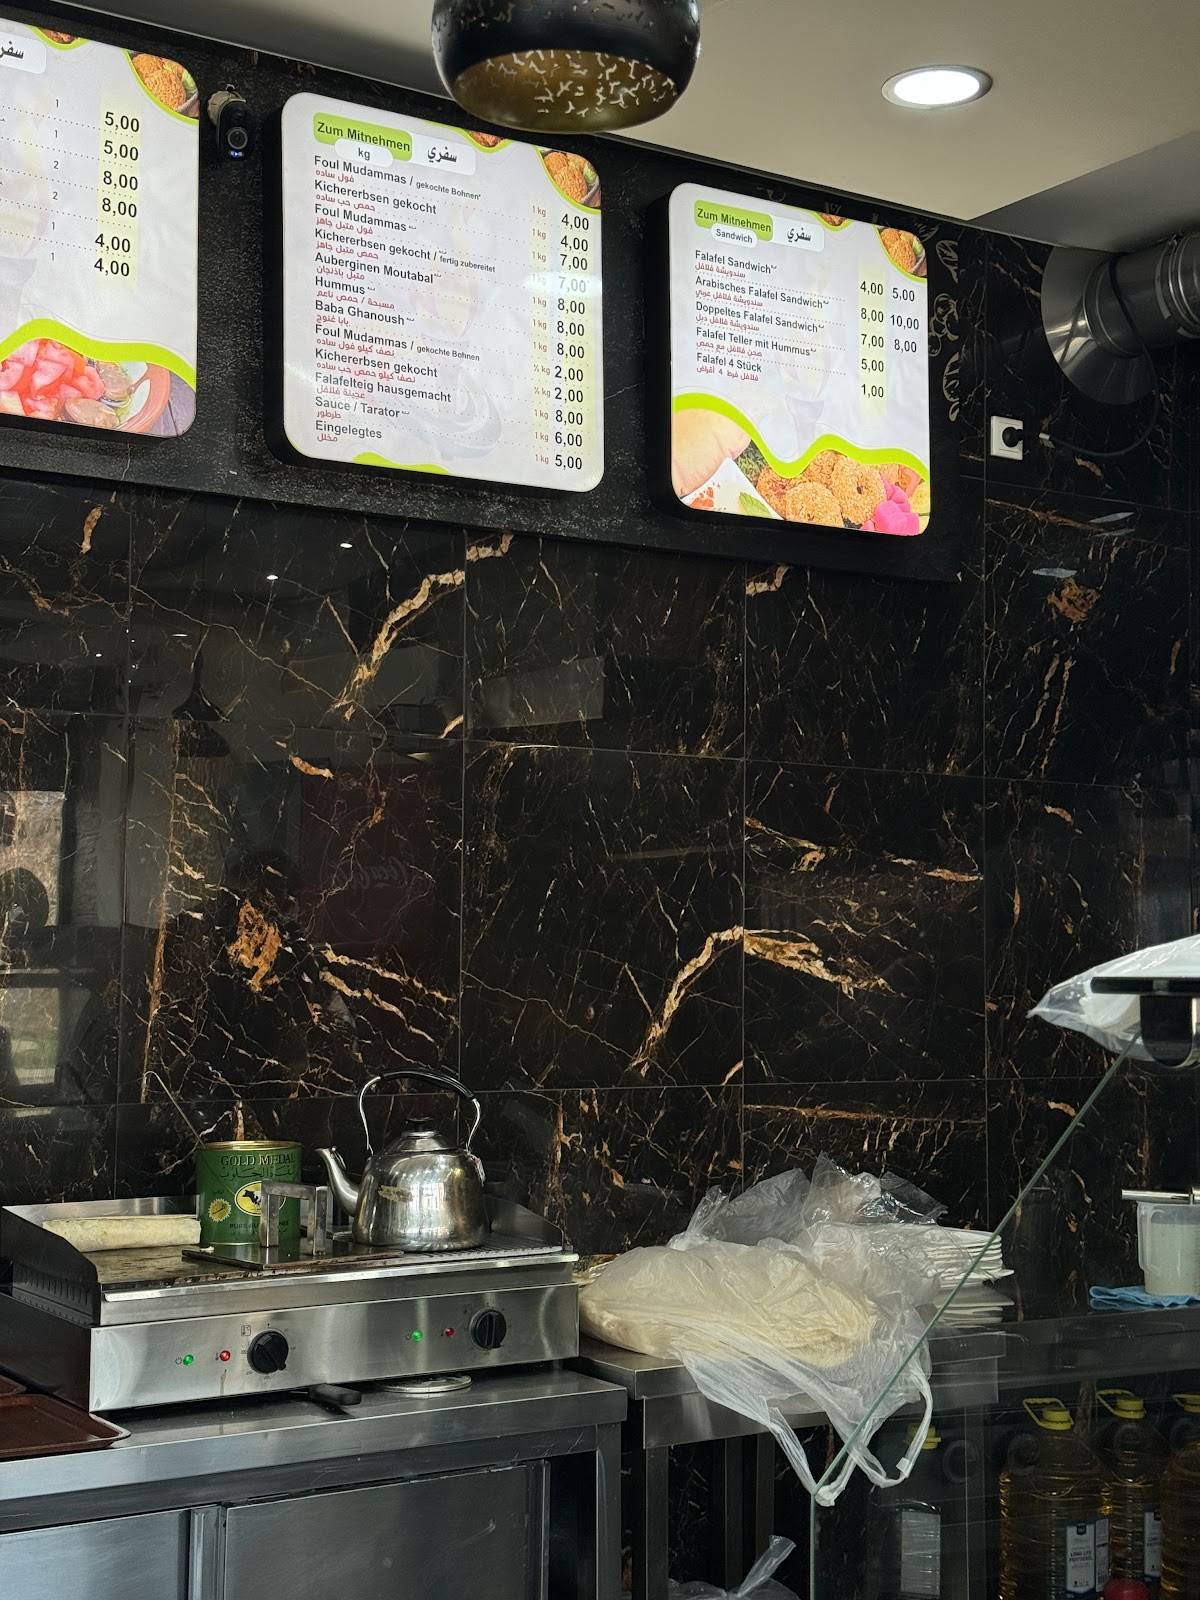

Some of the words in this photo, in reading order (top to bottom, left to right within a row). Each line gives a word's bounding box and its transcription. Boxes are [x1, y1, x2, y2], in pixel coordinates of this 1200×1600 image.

[104, 112, 139, 132] 5,00
[316, 122, 343, 137] Zum
[347, 128, 410, 152] Mitnehmen
[103, 140, 138, 160] 5,00
[358, 148, 370, 160] kg
[427, 145, 457, 164] سفري
[103, 171, 138, 190] 8,00
[314, 156, 339, 168] Foul
[343, 160, 406, 184] Mudammas
[416, 181, 449, 194] gekochte
[314, 180, 389, 204] Kichererbsen
[393, 198, 436, 214] gekocht
[102, 198, 137, 218] 8,00
[315, 204, 339, 218] Foul
[538, 207, 546, 217] kg
[562, 214, 589, 230] 4,00
[697, 208, 718, 220] Zum
[721, 213, 771, 232] Mitnehmen
[95, 234, 130, 253] 4,00
[538, 230, 546, 239] kg
[561, 236, 588, 252] 4,00
[716, 229, 753, 243] Sandwich
[787, 227, 812, 243] سفري
[315, 228, 386, 252] Kichererbsen
[389, 244, 430, 260] gekocht
[440, 255, 458, 266] fertig
[460, 260, 496, 272] zubereitet
[696, 250, 725, 264] Falafel
[94, 258, 130, 277] 4,00
[315, 252, 380, 274] Auberginen
[538, 253, 546, 262] kg
[560, 254, 587, 270] 7,00
[559, 276, 586, 292] 7,00
[696, 276, 746, 294] Arabisches
[749, 287, 778, 300] Falafel
[860, 281, 883, 295] 4,00
[892, 288, 915, 302] 5,00
[315, 300, 344, 314] Baba
[538, 298, 546, 307] kg
[558, 298, 585, 314] 8,00
[696, 301, 741, 318] Doppeltes
[744, 311, 772, 324] Falafel
[538, 320, 547, 330] kg
[557, 321, 584, 336] 8,00
[861, 308, 884, 322] 8,00
[890, 315, 919, 330] 10,00
[316, 324, 340, 338] Foul
[344, 329, 407, 349] Mudammas
[417, 344, 450, 356] gekochte
[452, 351, 480, 361] Bohnen
[696, 327, 726, 340] Falafel
[728, 333, 753, 345] Teller
[755, 338, 768, 349] mit
[861, 334, 884, 348] 7,00
[894, 339, 917, 353] 8,00
[539, 342, 547, 352] kg
[557, 343, 584, 358] 8,00
[316, 348, 390, 370] Kichererbsen
[394, 362, 438, 378] gekocht
[697, 353, 726, 366] Falafel
[729, 359, 733, 367] 4
[737, 360, 762, 373] Stück
[861, 359, 884, 372] 5,00
[542, 366, 550, 375] kg
[555, 366, 583, 381] 2,00
[316, 372, 373, 393] Falafelteig
[377, 383, 451, 402] hausgemacht
[542, 388, 551, 397] kg
[555, 387, 583, 403] 2,00
[861, 384, 884, 398] 1,00
[315, 396, 354, 411] Sauce
[540, 410, 548, 419] kg
[556, 410, 583, 425] 8,00
[316, 420, 382, 439] Eingelegtes
[540, 432, 548, 441] kg
[555, 432, 582, 447] 6,00
[540, 455, 549, 464] kg
[555, 455, 582, 470] 5,00
[221, 1154, 255, 1166] GOLD
[259, 1153, 296, 1165] MEDAL
